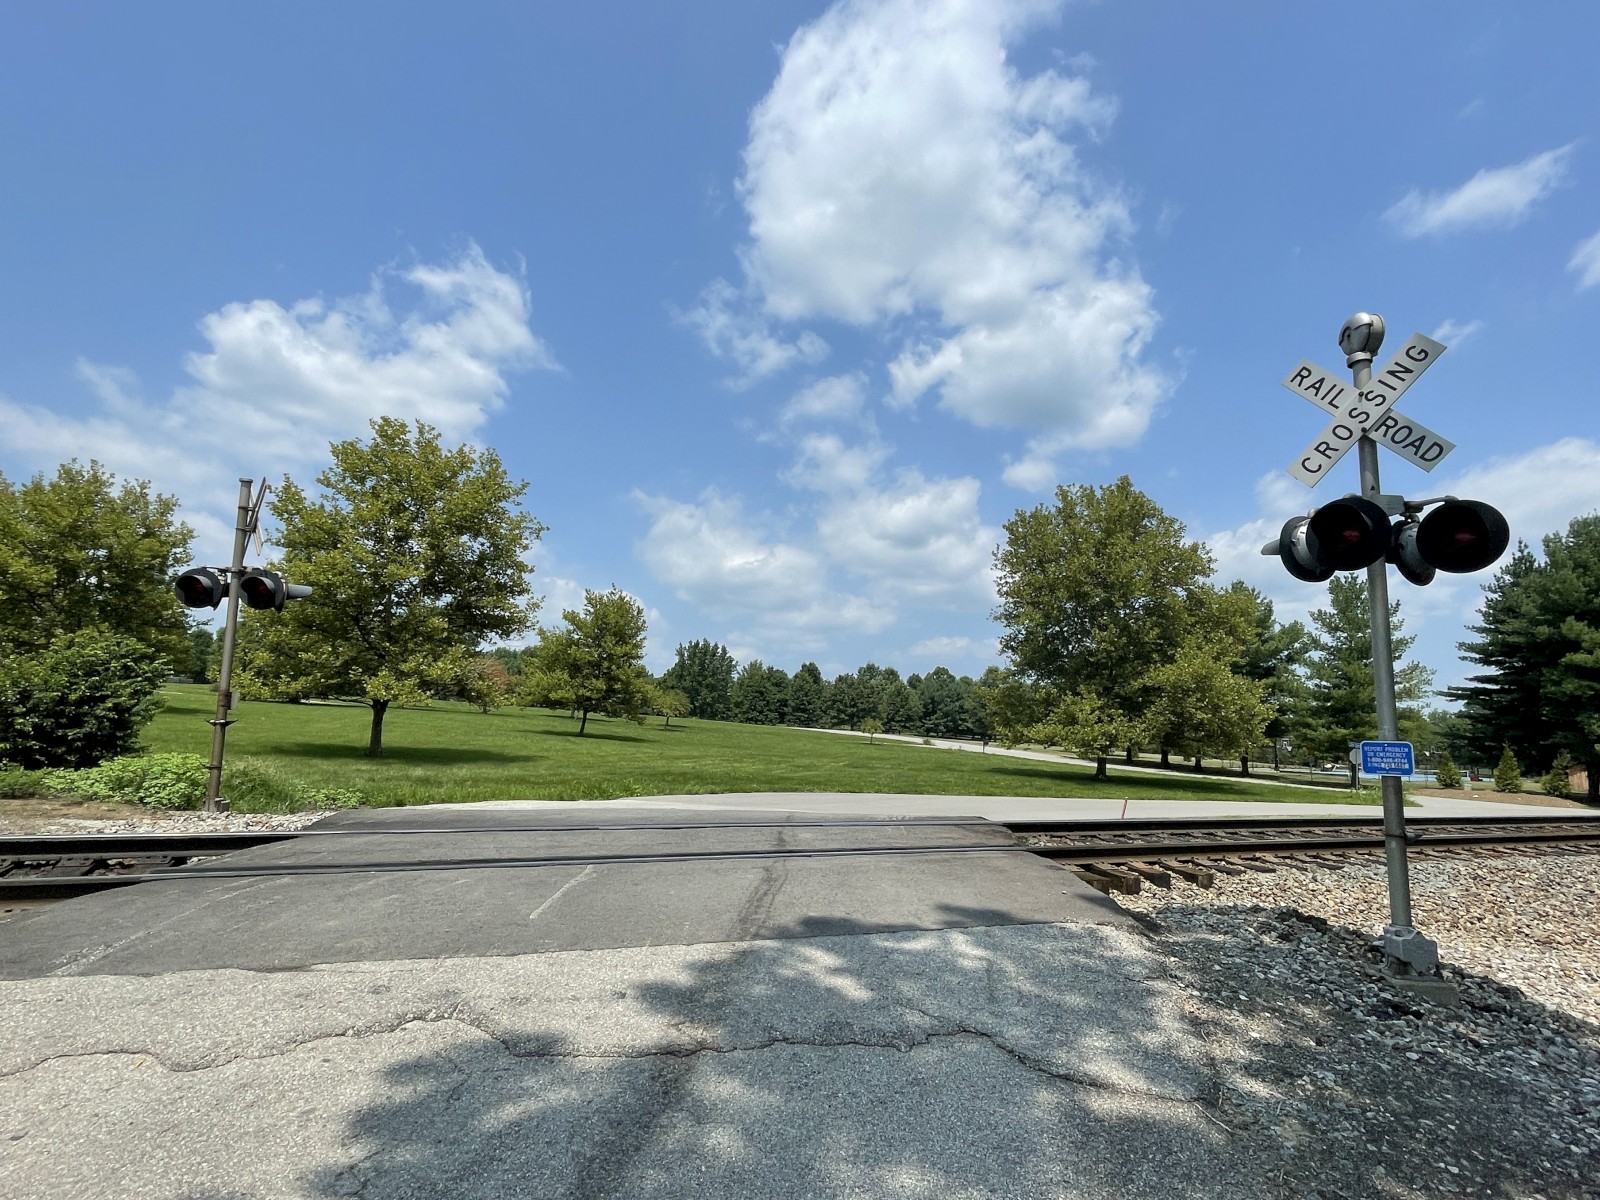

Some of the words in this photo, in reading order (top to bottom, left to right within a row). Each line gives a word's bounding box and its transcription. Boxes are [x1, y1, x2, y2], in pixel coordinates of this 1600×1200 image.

[1290, 366, 1344, 409] RAIL
[1374, 415, 1444, 463] ROAD
[1301, 345, 1429, 474] CROSSING
